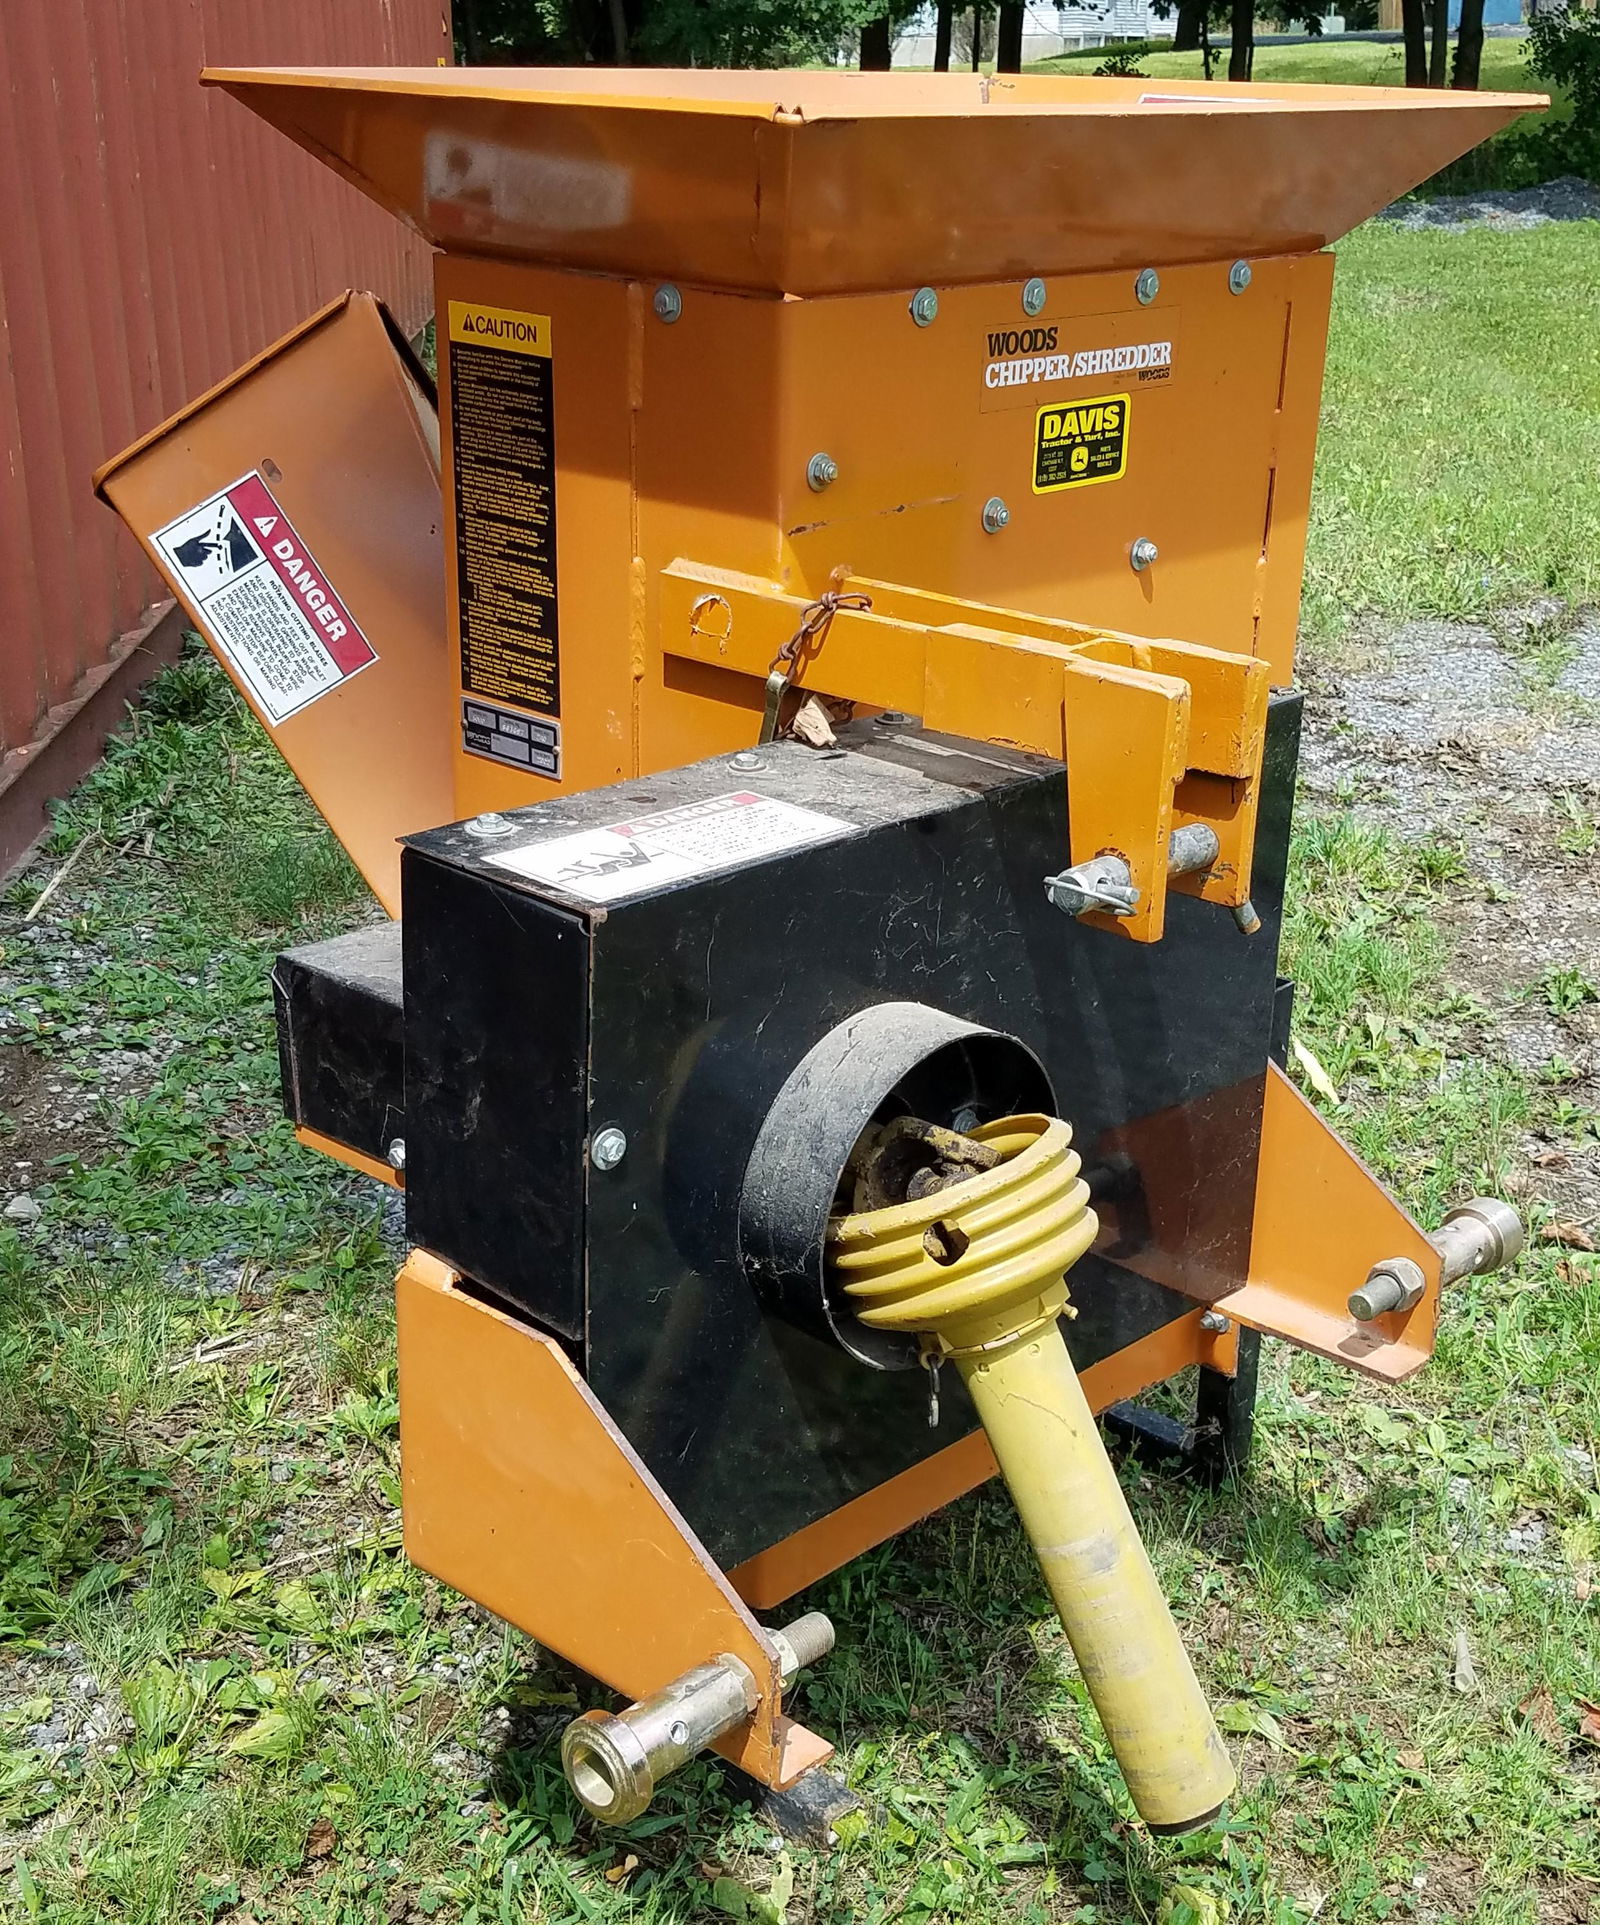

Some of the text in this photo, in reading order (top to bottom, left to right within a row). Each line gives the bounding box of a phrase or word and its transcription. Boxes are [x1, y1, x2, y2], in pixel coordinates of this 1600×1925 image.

[476, 315, 537, 343] CAUTION
[986, 341, 1170, 388] CHIPPER/SHREDDER
[988, 327, 1057, 357] WOODS
[1041, 439, 1072, 448] Tractor
[1084, 432, 1102, 442] Turf,
[1105, 429, 1120, 437] Inc.
[1043, 405, 1119, 439] DAVIS
[248, 579, 259, 591] AND
[257, 592, 281, 625] DISCHARGE
[280, 627, 302, 656] OPENINGS
[254, 575, 325, 680] KEEP HANDS AND FEET OUT OF INLET
[269, 580, 327, 666] ROTATING CUTTING BLADES
[273, 539, 347, 640] DANGER
[215, 600, 224, 610] ING
[222, 611, 254, 655] OBSTRUCTIONS
[252, 656, 260, 665] OR
[259, 667, 276, 689] MAKING
[224, 602, 247, 632] COMPLETE
[245, 634, 258, 650] STOP
[256, 650, 274, 674] BEFORE
[226, 593, 292, 691] AND ALLOW MACHINE TO COME TO
[237, 586, 256, 611] SERIOUS
[255, 612, 277, 642] PERSONAL
[292, 669, 304, 684] STOP
[243, 582, 262, 607] MACHINE
[265, 617, 288, 648] OPERATING
[288, 650, 295, 658] TO
[293, 659, 307, 676] AVOID
[247, 613, 265, 637] REMOVE
[264, 638, 279, 657] SPARK
[277, 659, 290, 674] PLUG
[288, 675, 300, 690] WIRE
[650, 799, 735, 828] DANGER
